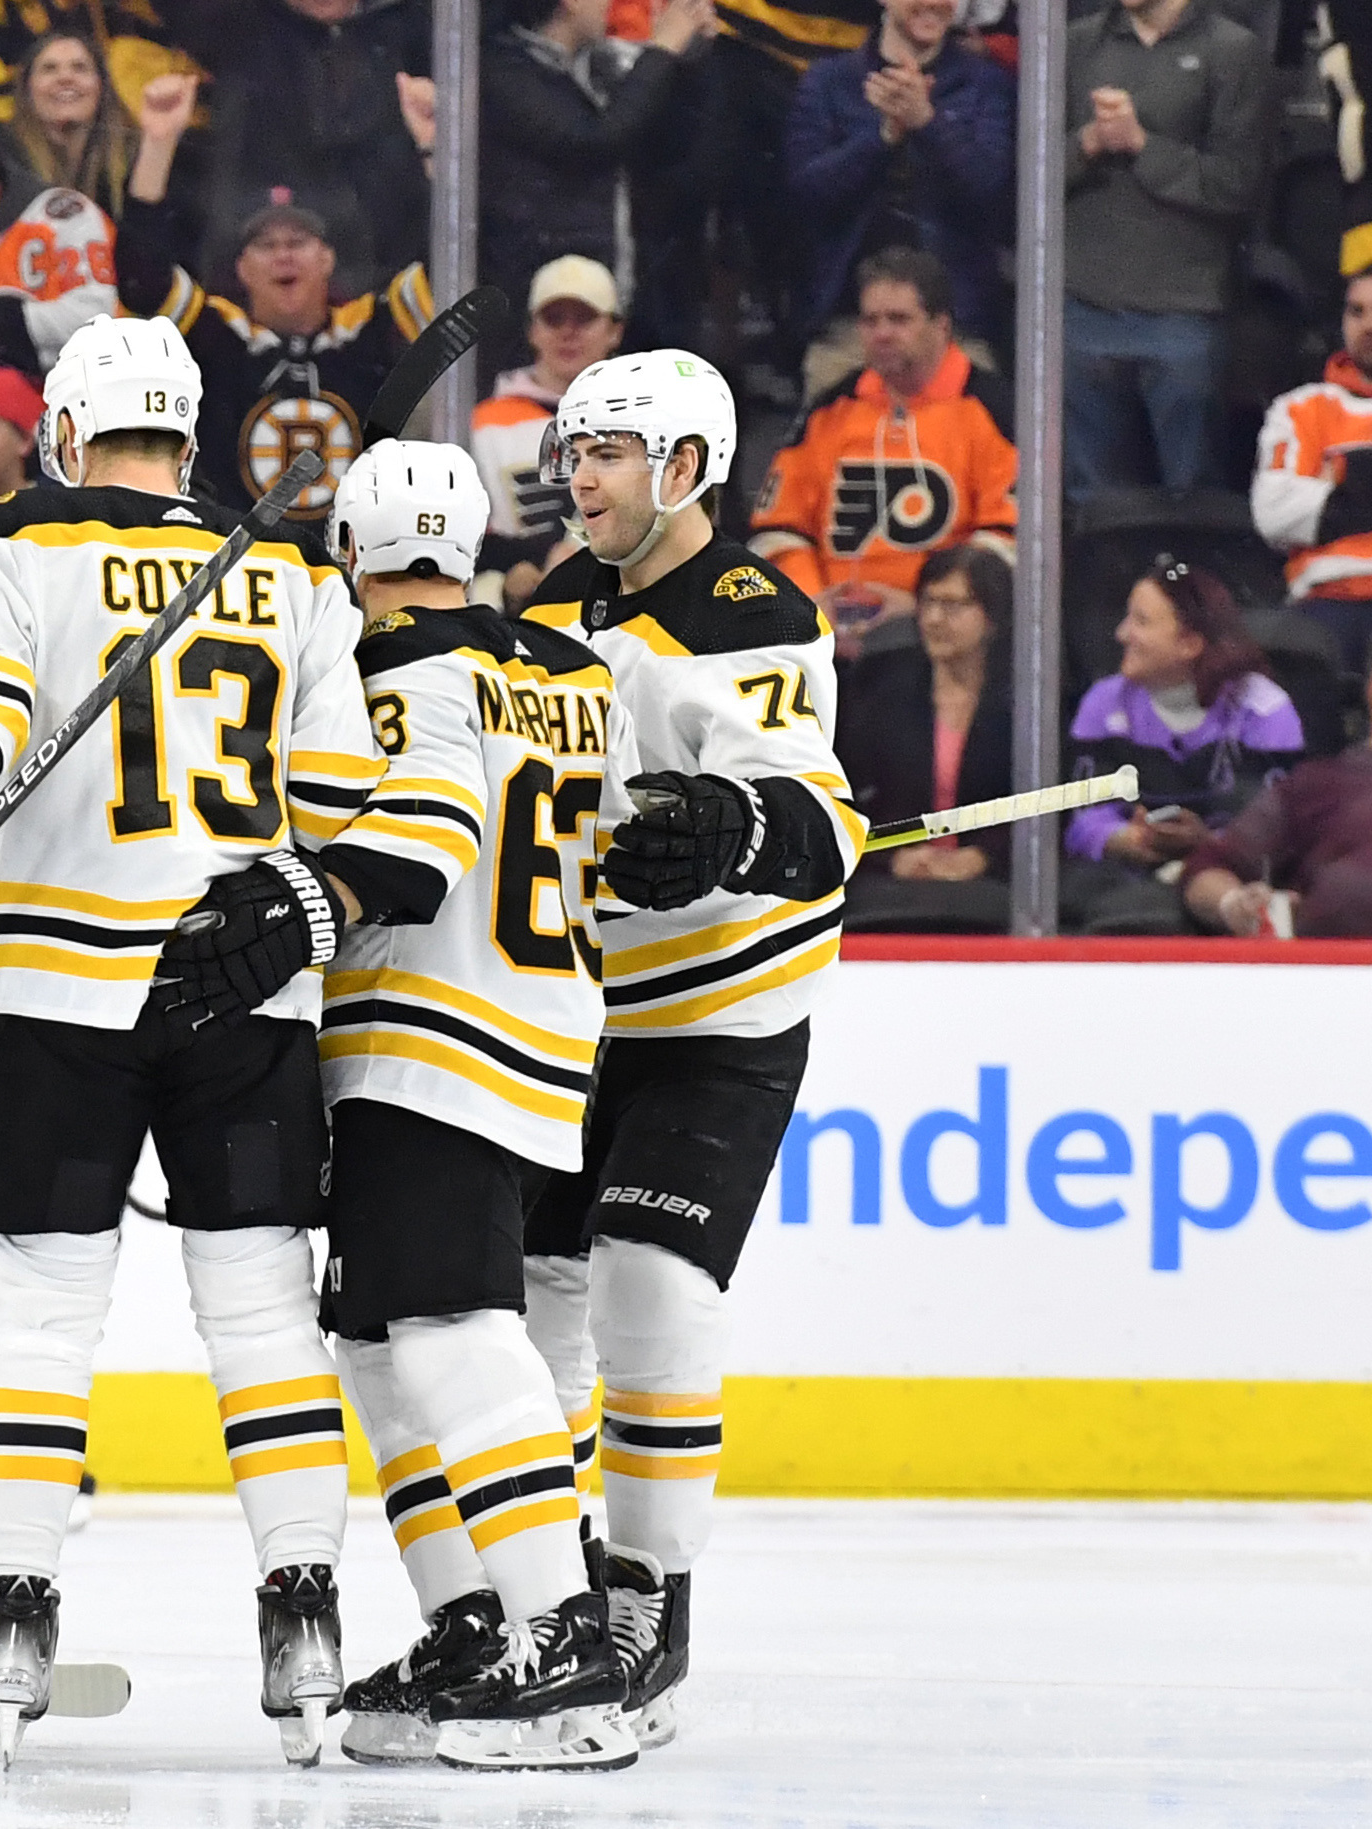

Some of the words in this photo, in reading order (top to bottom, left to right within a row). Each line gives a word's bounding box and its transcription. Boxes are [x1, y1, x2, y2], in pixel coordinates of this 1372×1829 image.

[144, 390, 166, 413] 13
[416, 513, 446, 537] 63
[98, 626, 288, 847] 13
[260, 850, 336, 966] WARRIOR
